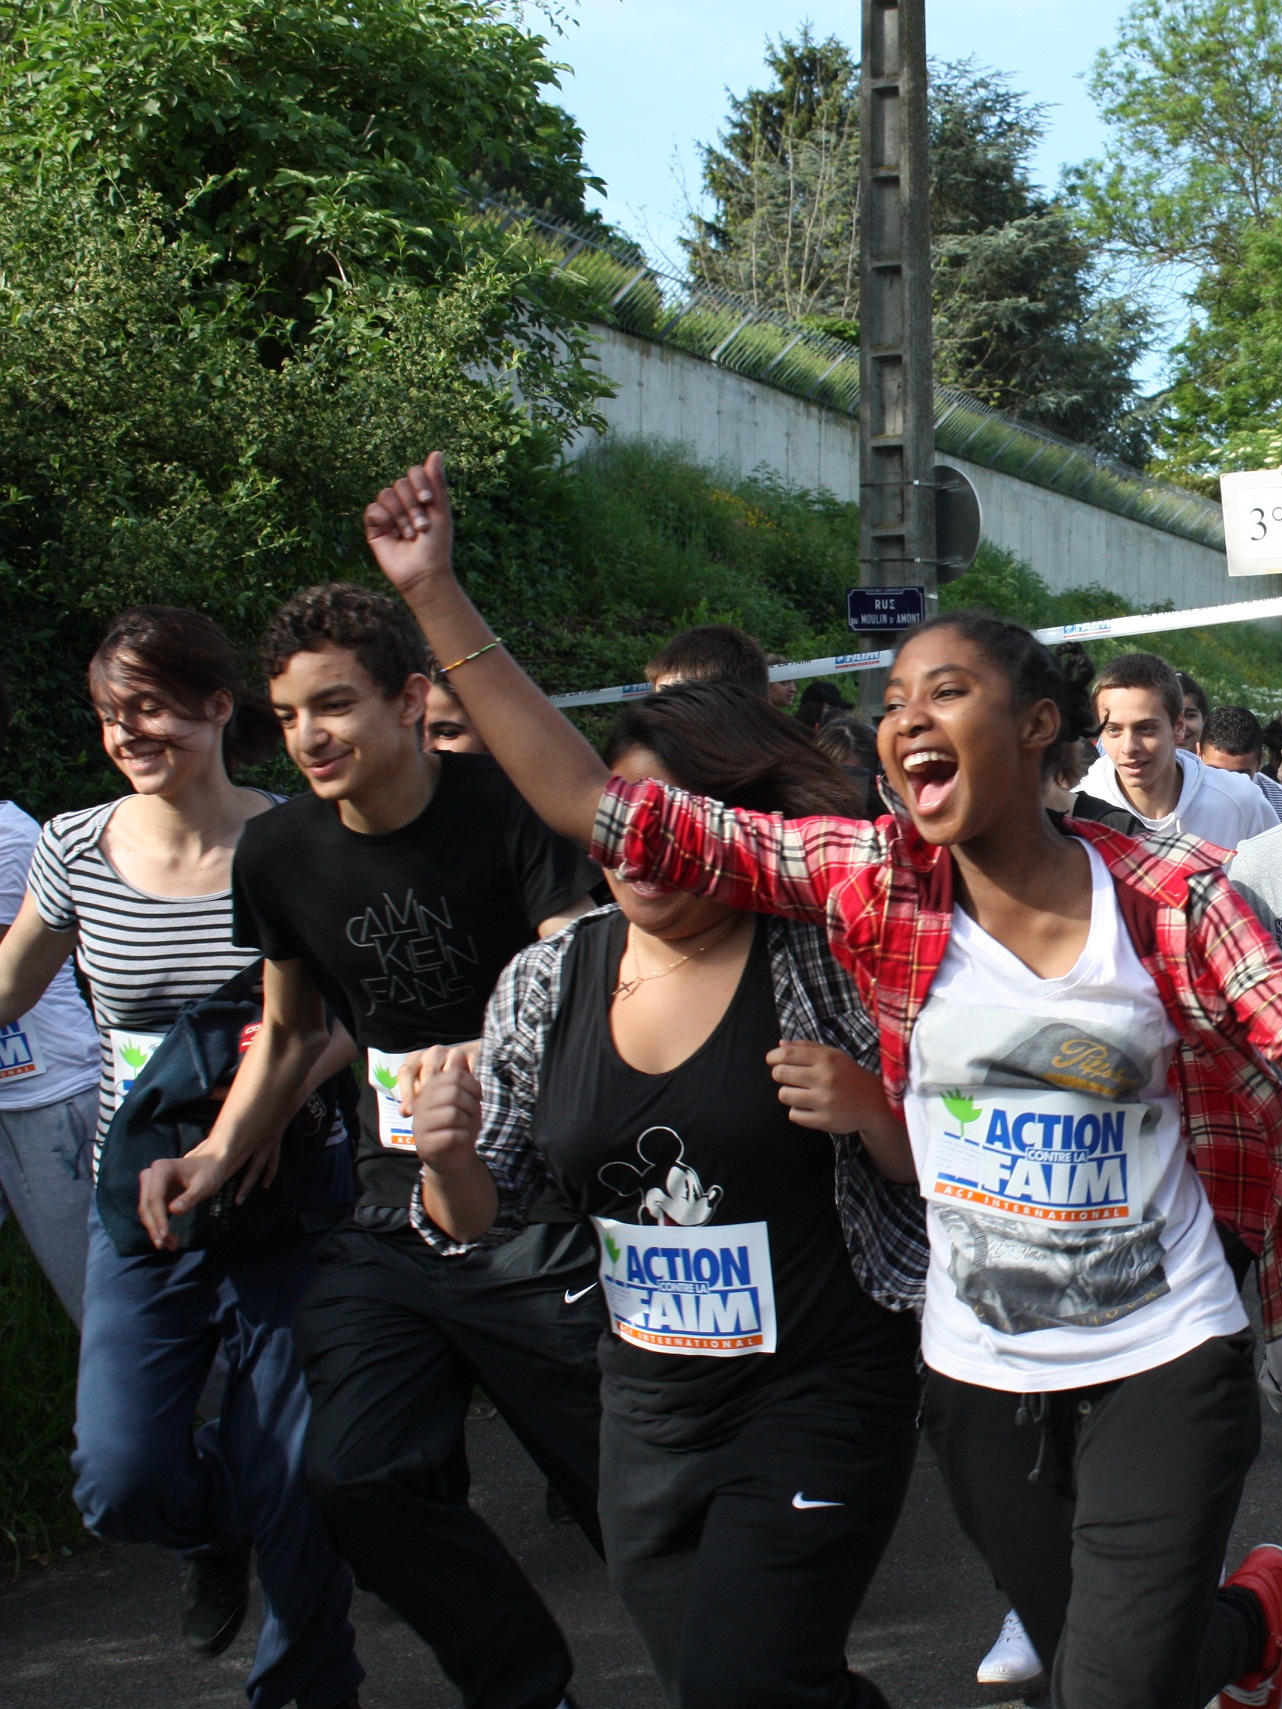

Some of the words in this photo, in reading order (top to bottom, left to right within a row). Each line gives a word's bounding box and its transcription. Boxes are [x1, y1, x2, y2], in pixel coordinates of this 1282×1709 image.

[861, 614, 888, 624] MOULIN
[896, 613, 920, 624] AMONT
[875, 599, 896, 610] RUE
[346, 888, 453, 947] CALVIN
[360, 971, 475, 1016] JEANS
[985, 1108, 1126, 1154] ACTION
[1028, 1150, 1072, 1163] CONTRE
[1073, 1151, 1087, 1163] LA
[982, 1152, 1126, 1205] FAIM
[943, 1186, 973, 1200] ACF
[984, 1195, 1121, 1221] INTERNATIONAL
[627, 1245, 751, 1289] ACTION
[660, 1282, 694, 1294] CONTRE
[696, 1283, 709, 1294] LA
[631, 1288, 760, 1333] FAIM
[638, 1332, 754, 1349] INTERNATIONAL
